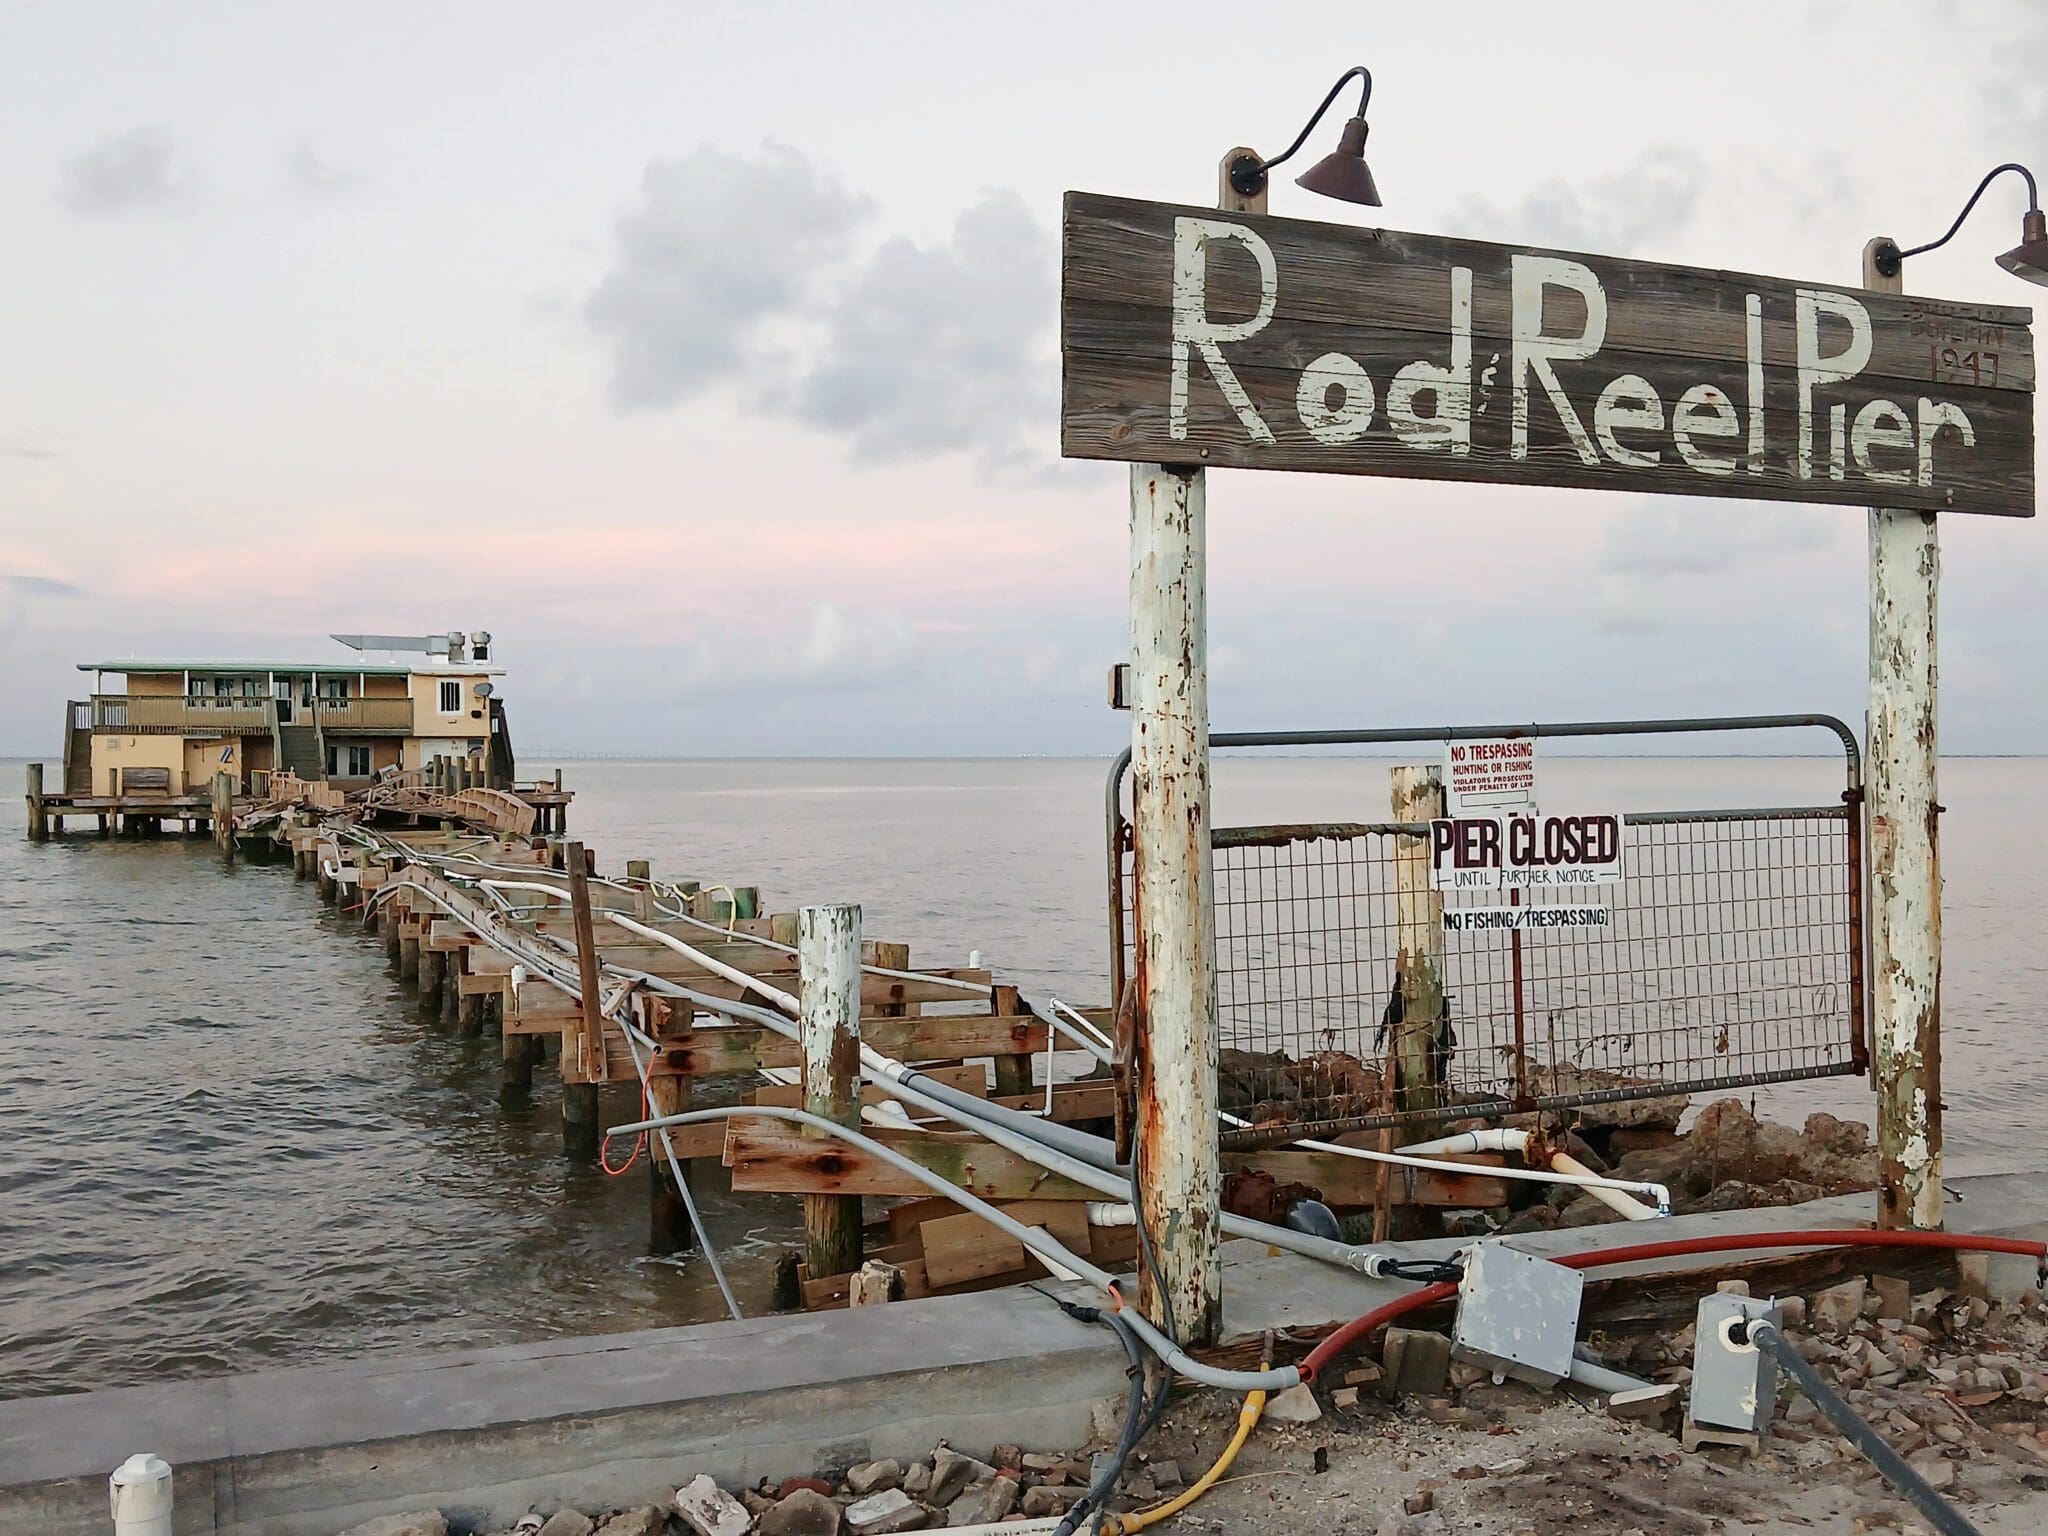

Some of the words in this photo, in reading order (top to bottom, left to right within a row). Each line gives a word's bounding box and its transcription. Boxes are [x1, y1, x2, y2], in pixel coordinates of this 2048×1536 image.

[1170, 216, 1472, 457] Rod
[1510, 254, 1764, 478] Reel
[1796, 288, 1976, 488] Pier
[1930, 345, 1999, 388] 1947
[1451, 746, 1466, 761] NO
[1469, 743, 1533, 760] TRESPASSING
[1453, 764, 1488, 775] HUNTING
[1491, 763, 1502, 773] OR
[1505, 761, 1533, 772] FISHING
[1453, 777, 1490, 785] VIOLATORS
[1494, 774, 1533, 782] PROSECUTED
[1432, 820, 1502, 869] PIER
[1509, 816, 1617, 866] CLOSED
[1454, 870, 1491, 887] UNTIL
[1500, 869, 1552, 884] FURTHER
[1556, 869, 1596, 884] NOTICE
[1443, 912, 1461, 930] NO
